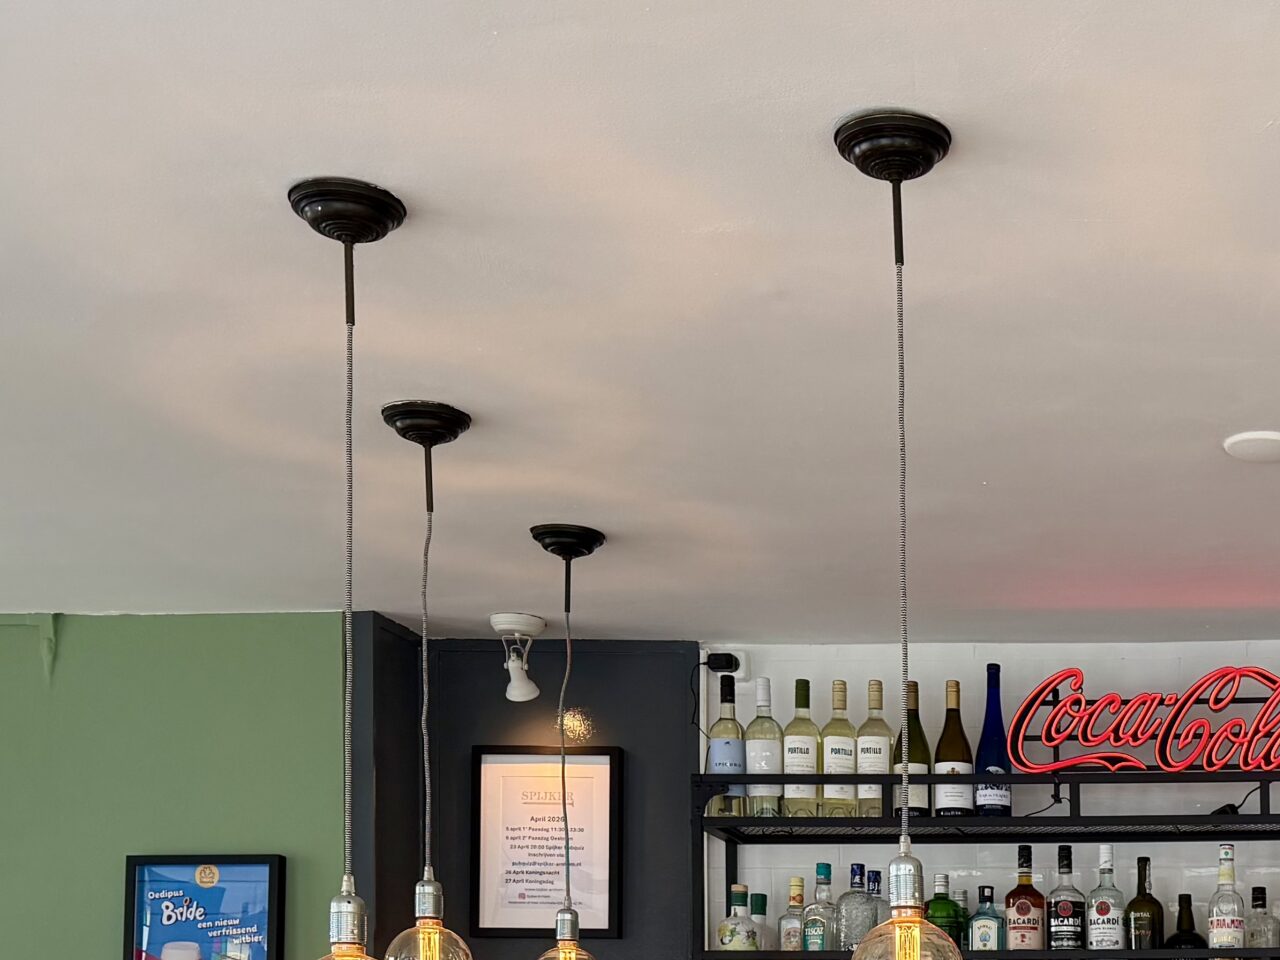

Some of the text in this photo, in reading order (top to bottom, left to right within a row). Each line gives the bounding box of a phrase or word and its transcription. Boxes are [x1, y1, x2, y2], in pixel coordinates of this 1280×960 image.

[788, 747, 810, 755] PORTILLO
[830, 747, 853, 756] PORTILLO
[860, 747, 882, 755] PORTILLO
[148, 889, 184, 900] Oedipus
[161, 897, 206, 925] Bride
[197, 918, 240, 929] een nieuw
[207, 925, 258, 938] verfrissend
[232, 935, 264, 945] witbier
